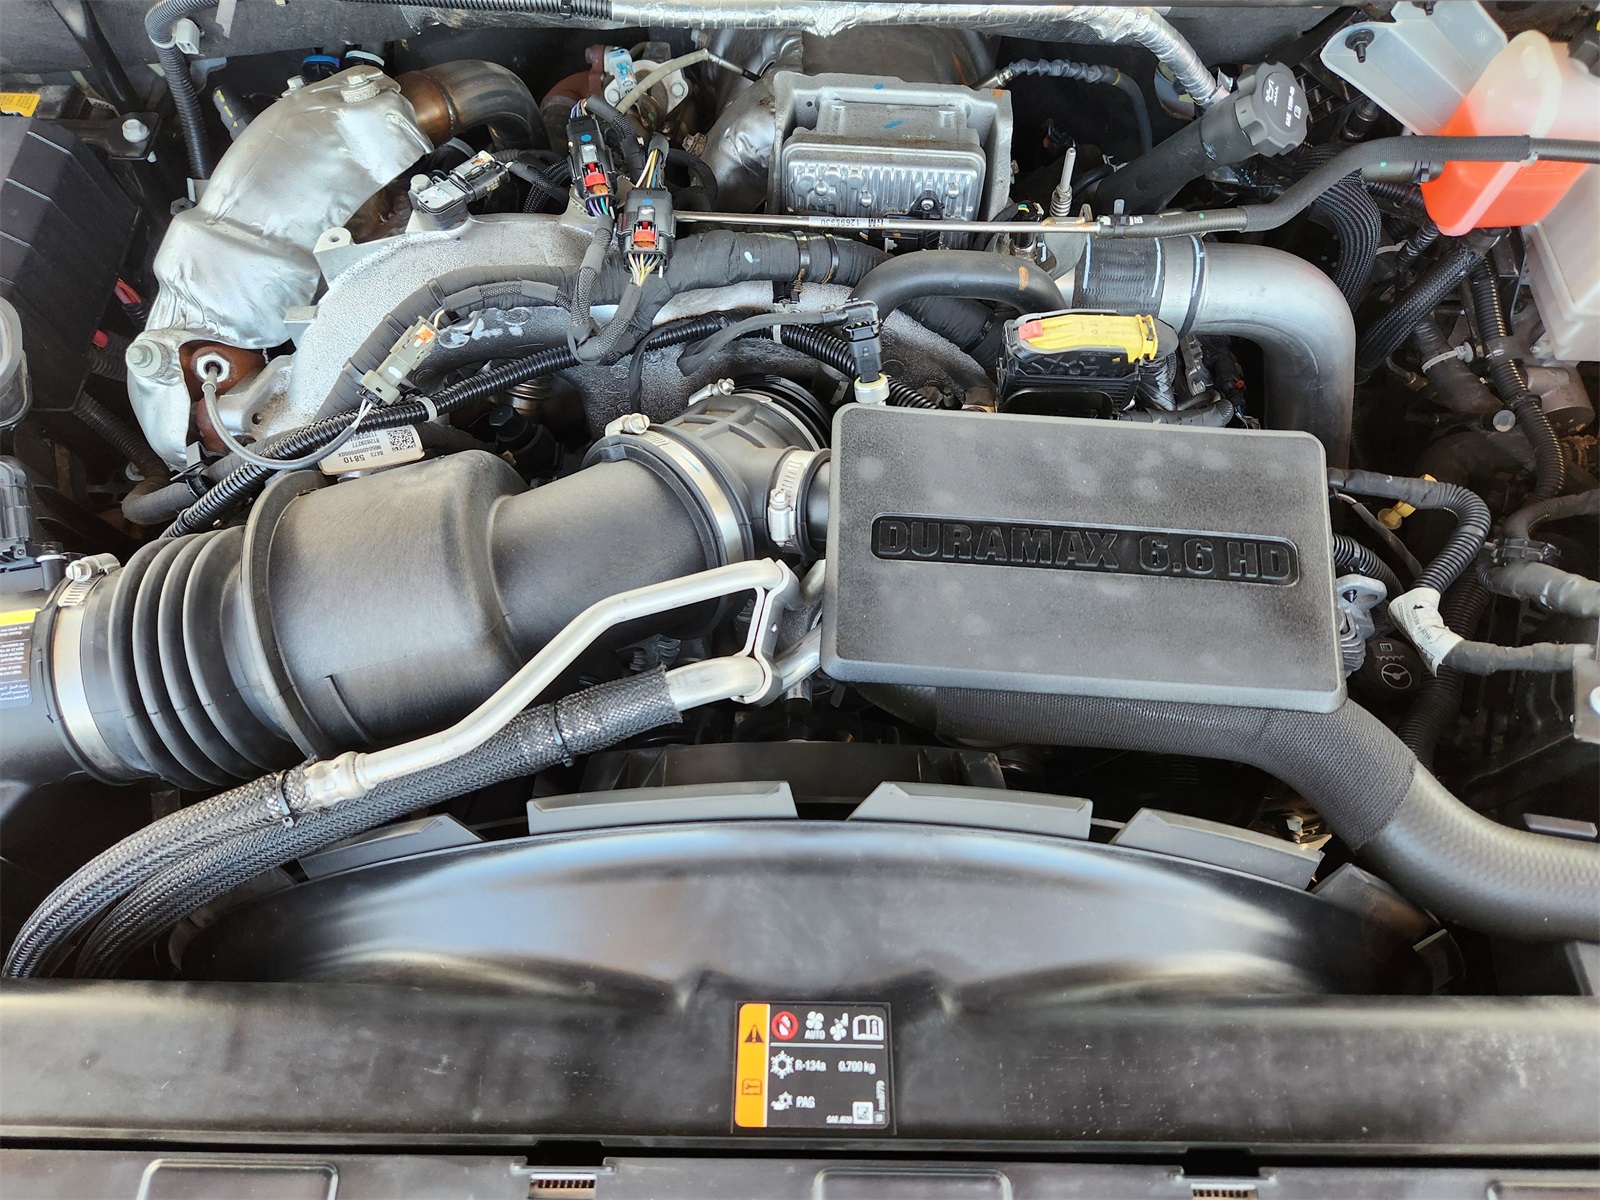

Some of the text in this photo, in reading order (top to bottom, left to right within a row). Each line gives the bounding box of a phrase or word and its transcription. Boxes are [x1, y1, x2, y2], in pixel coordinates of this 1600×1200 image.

[343, 454, 366, 464] 5810
[878, 520, 1293, 580] DURAMAX 6.6 HD
[804, 1030, 826, 1040] AUTO
[795, 1059, 876, 1075] R-134a 0.700 kg
[796, 1096, 816, 1109] PAG
